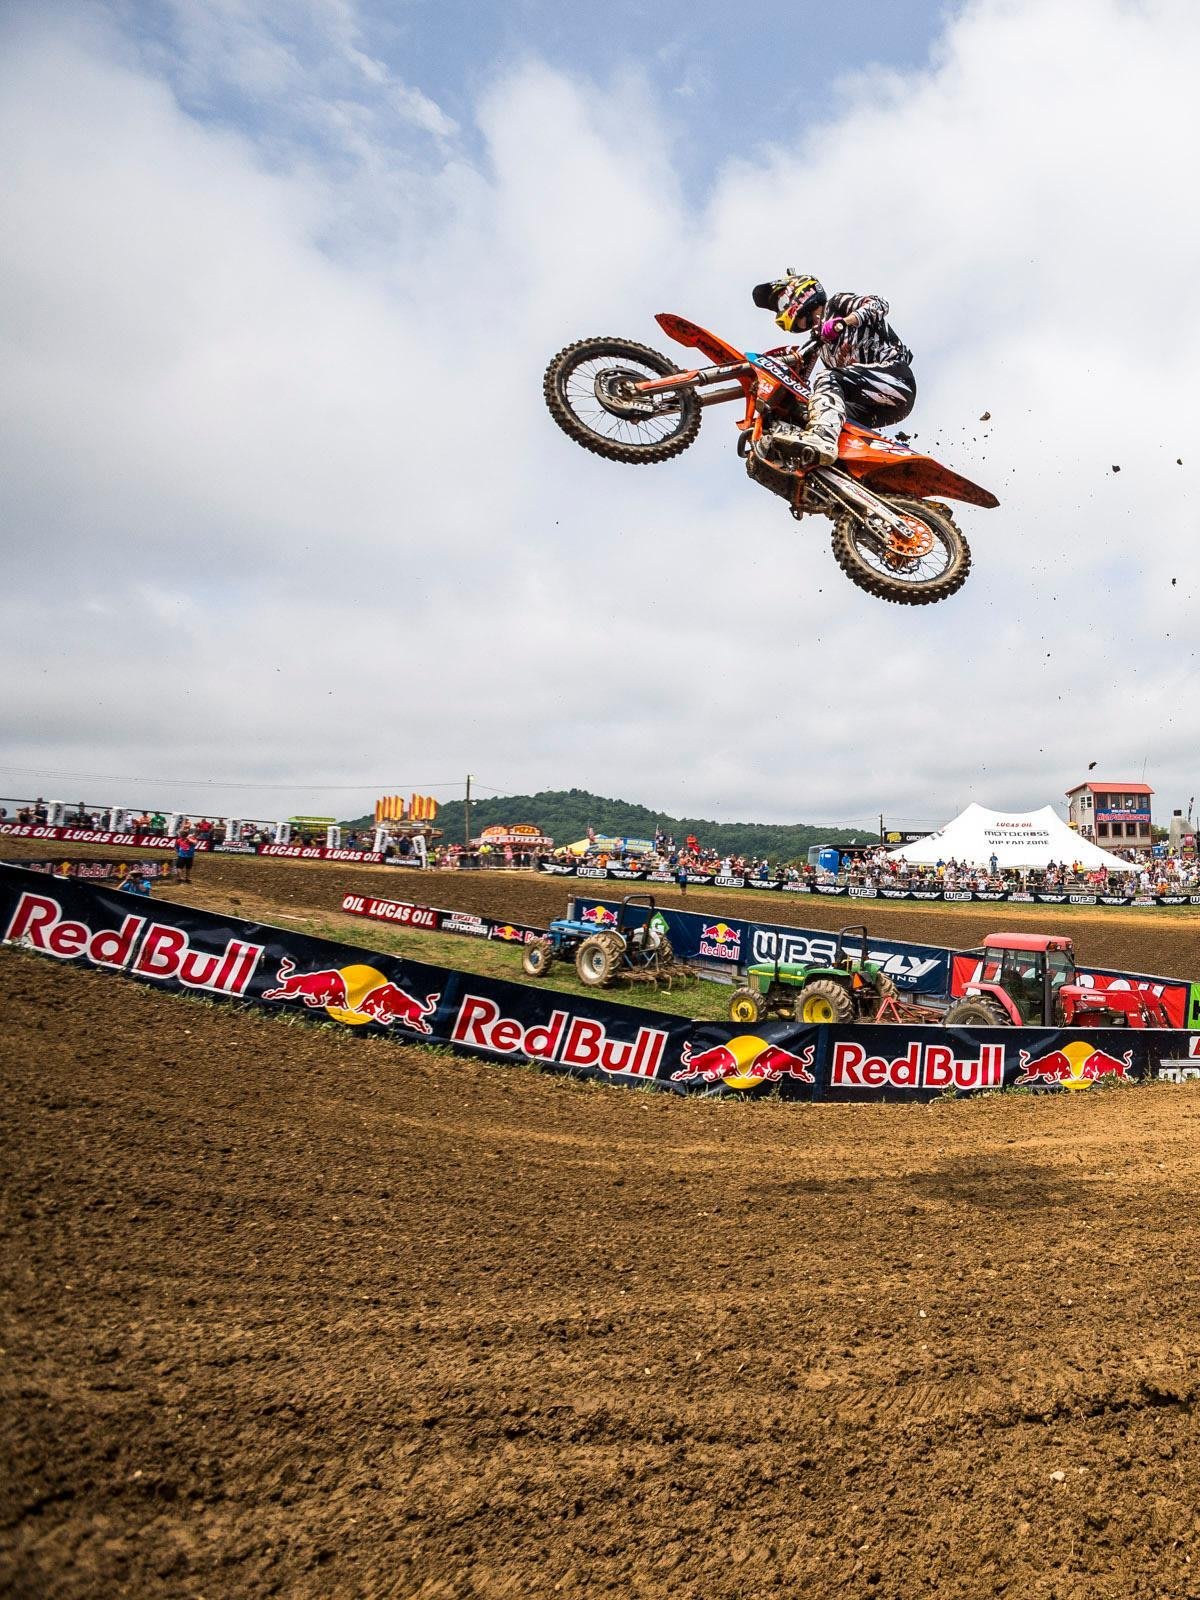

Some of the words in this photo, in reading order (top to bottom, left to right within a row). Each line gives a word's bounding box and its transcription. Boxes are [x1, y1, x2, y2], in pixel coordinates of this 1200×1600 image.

[756, 356, 794, 386] LUCAS
[793, 382, 813, 400] OIL
[0, 823, 32, 836] CAS
[33, 826, 58, 838] OIL
[64, 829, 112, 843] LUCAS
[112, 832, 135, 845] OIL
[140, 836, 176, 848] LUCA
[262, 845, 302, 858] LUCAS
[302, 848, 321, 858] OIL
[325, 850, 363, 861] LUCAS
[363, 852, 383, 863] OIL
[576, 867, 608, 878] WPS
[714, 876, 745, 888] WPS
[848, 887, 878, 898] WPS
[944, 891, 973, 901] WPS
[1069, 895, 1097, 905] WPS
[342, 895, 364, 910] OIL
[369, 902, 411, 921] LUCAS
[411, 911, 434, 926] OIL
[2, 892, 147, 969] Red
[131, 922, 266, 997] Bull
[700, 941, 719, 956] Red
[719, 943, 740, 961] Bull
[753, 930, 837, 965] WPS
[450, 994, 569, 1062] Red
[559, 1016, 669, 1079] Bull
[830, 1042, 922, 1088] Red
[922, 1044, 1005, 1089] Bull
